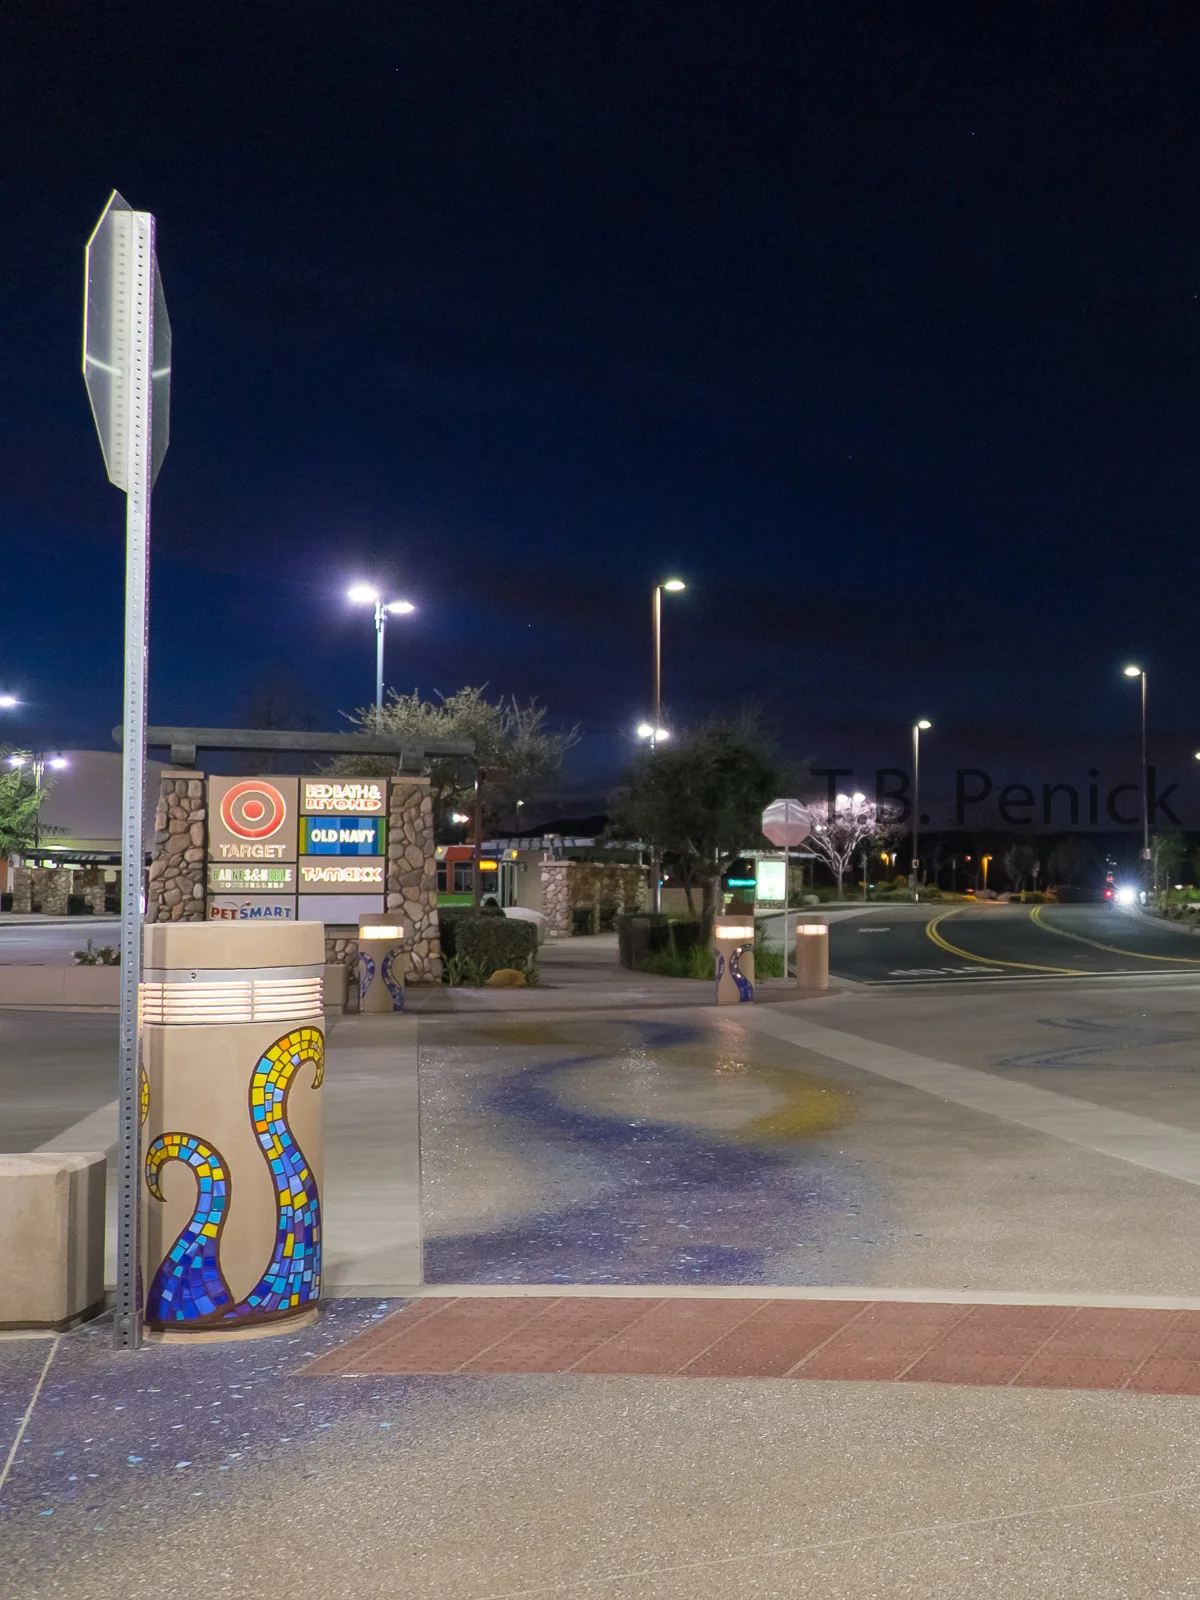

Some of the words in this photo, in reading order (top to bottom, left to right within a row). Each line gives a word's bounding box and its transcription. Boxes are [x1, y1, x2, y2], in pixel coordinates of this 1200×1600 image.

[306, 784, 333, 798] BED
[333, 784, 369, 799] BATH
[369, 784, 382, 800] &
[306, 798, 382, 811] BEYOND
[311, 829, 339, 843] OLD
[340, 829, 376, 843] NAVY
[219, 843, 286, 858] TARGET
